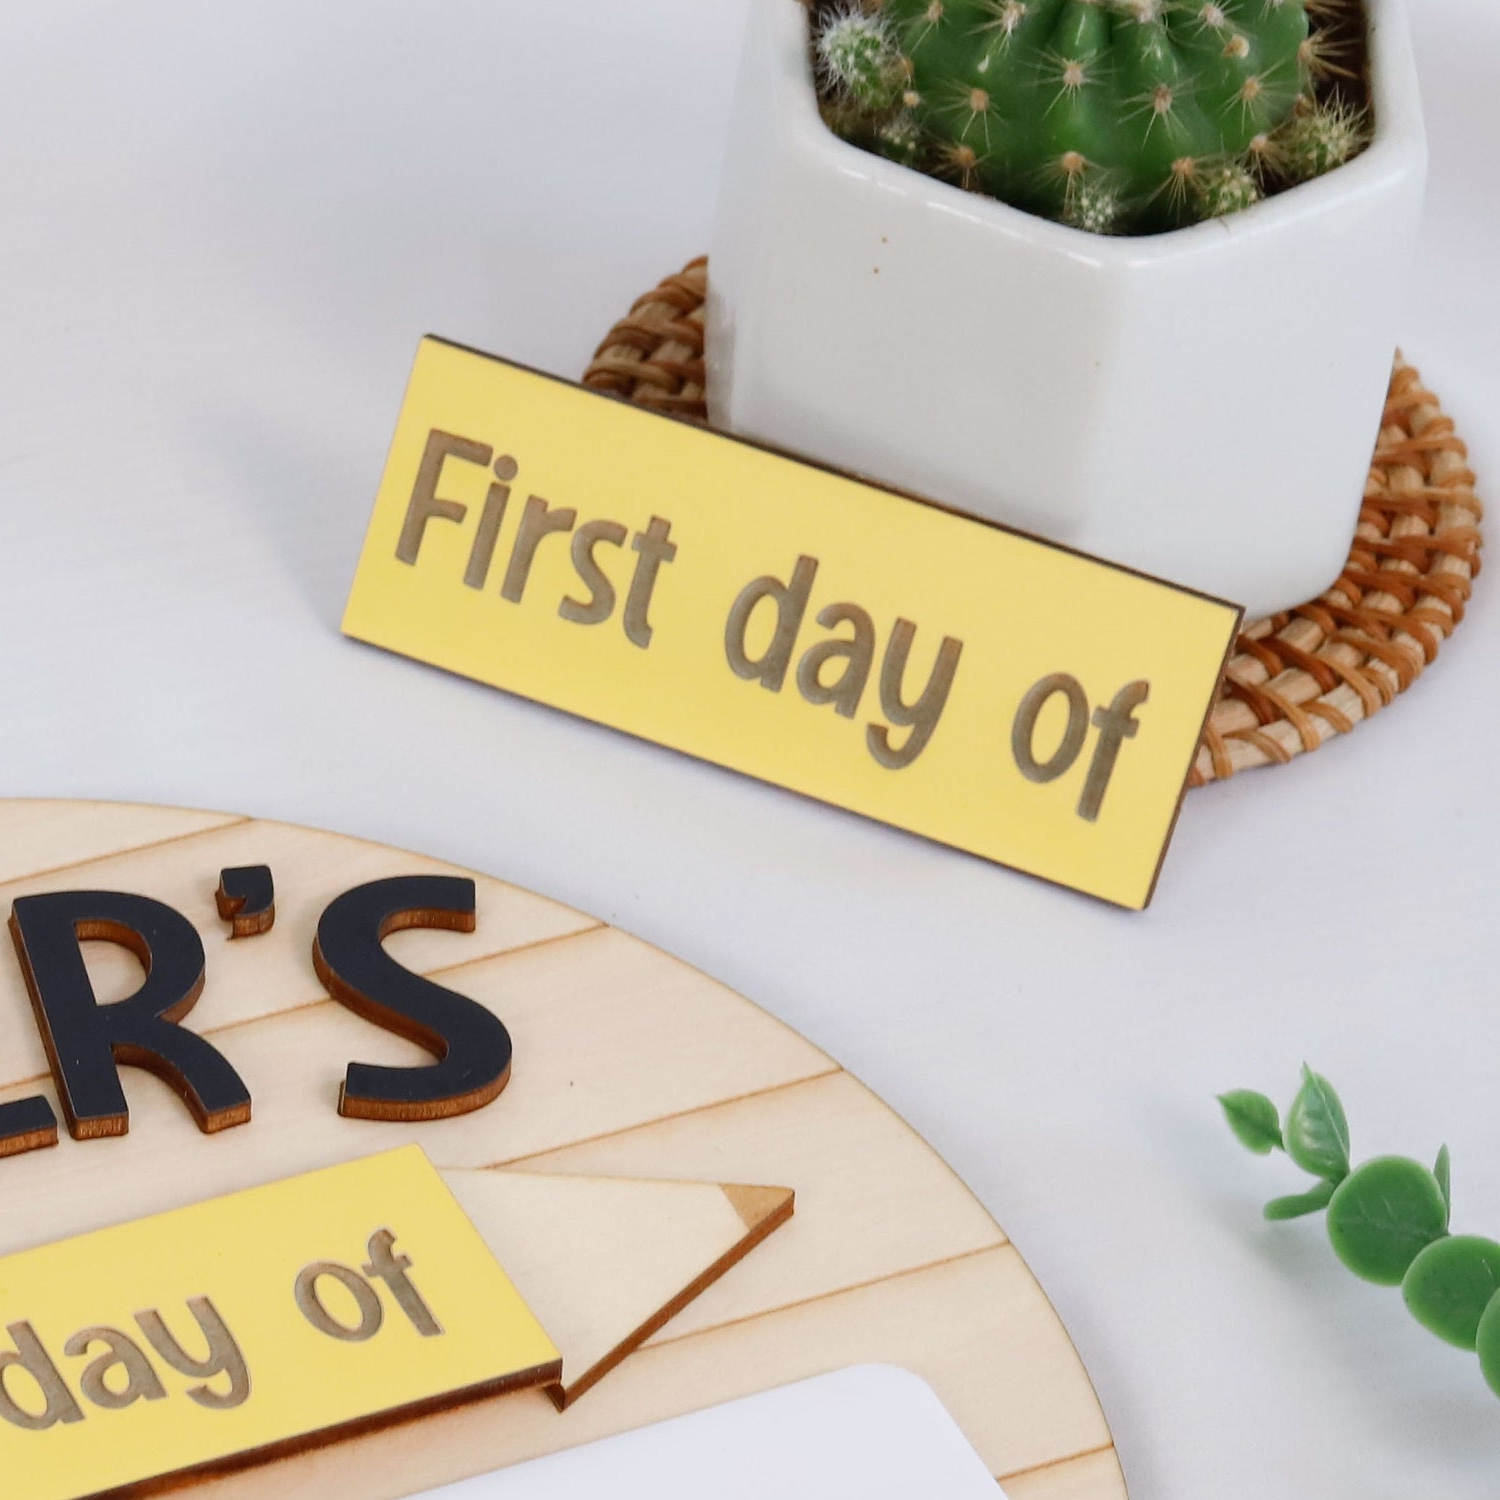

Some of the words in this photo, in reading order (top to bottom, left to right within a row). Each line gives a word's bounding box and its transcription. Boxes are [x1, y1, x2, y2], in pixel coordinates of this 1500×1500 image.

[394, 428, 677, 649] First
[723, 554, 963, 770] day
[1011, 671, 1150, 823] of
[294, 1226, 446, 1343] of
